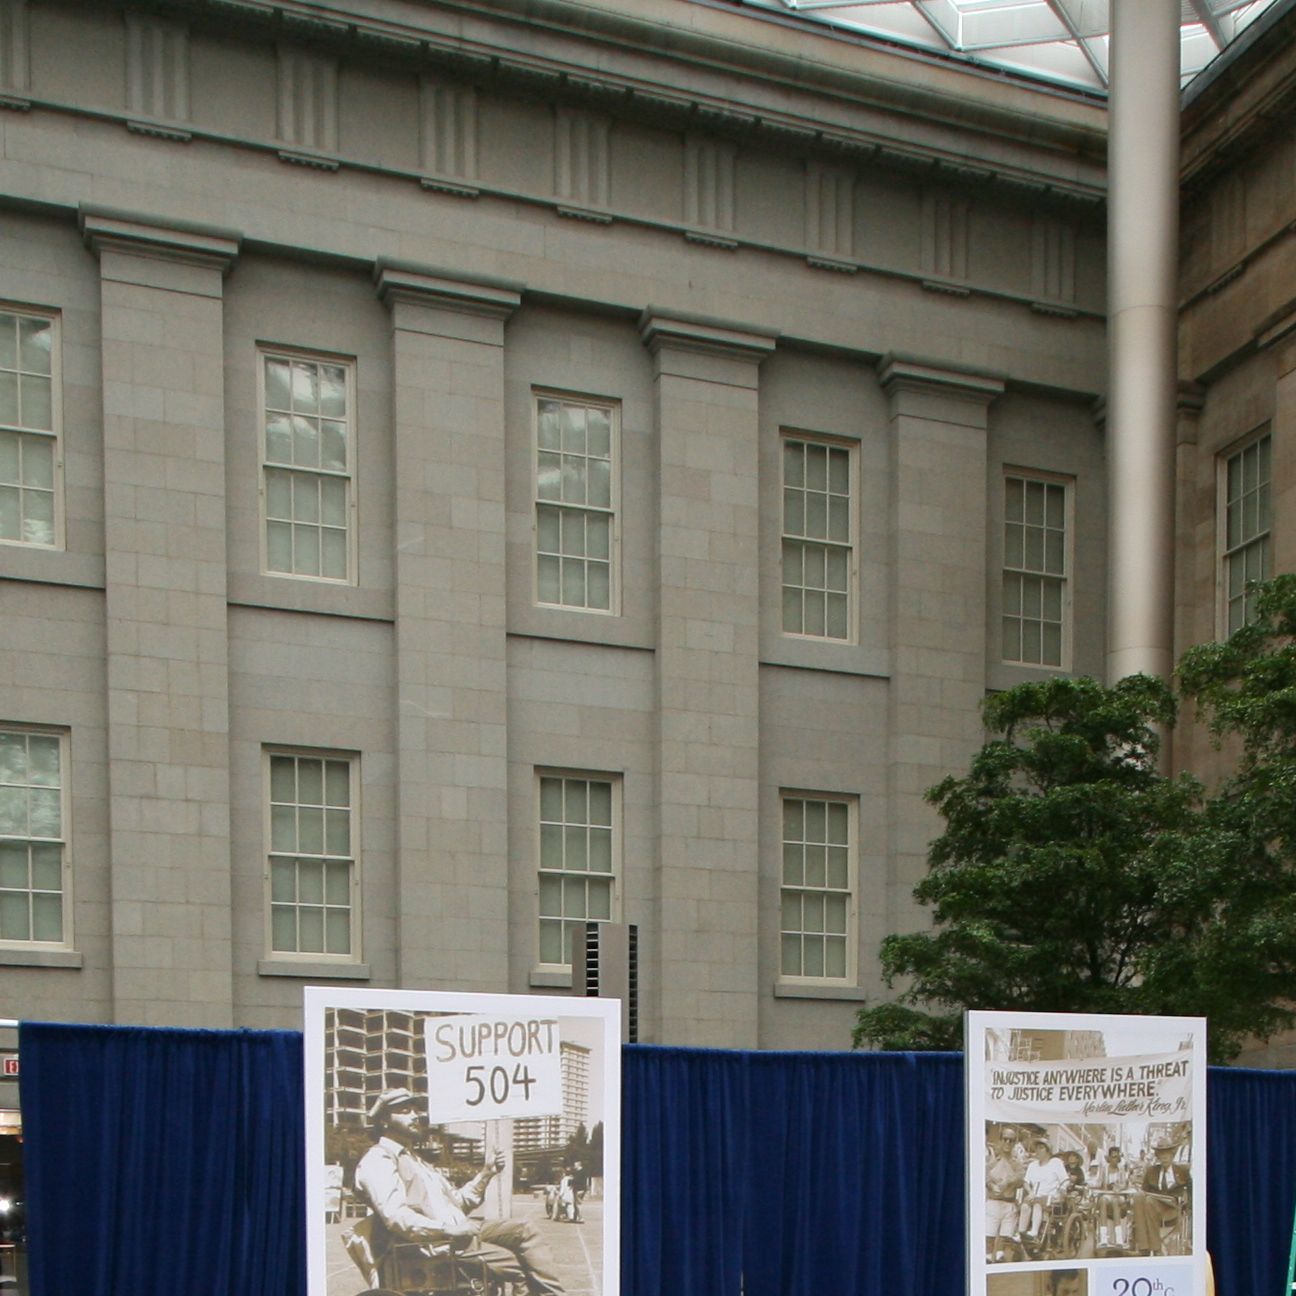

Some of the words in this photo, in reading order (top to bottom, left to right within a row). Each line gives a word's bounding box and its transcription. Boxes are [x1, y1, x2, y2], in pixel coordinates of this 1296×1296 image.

[435, 1019, 558, 1063] SUPPORT
[465, 1063, 537, 1106] 504
[1042, 1068, 1107, 1086] ANYWHERE
[1110, 1067, 1123, 1083] IS
[1125, 1066, 1135, 1081] A
[1139, 1060, 1189, 1081] THREAT
[991, 1086, 1005, 1100] TO
[1008, 1086, 1055, 1101] JUSTICE
